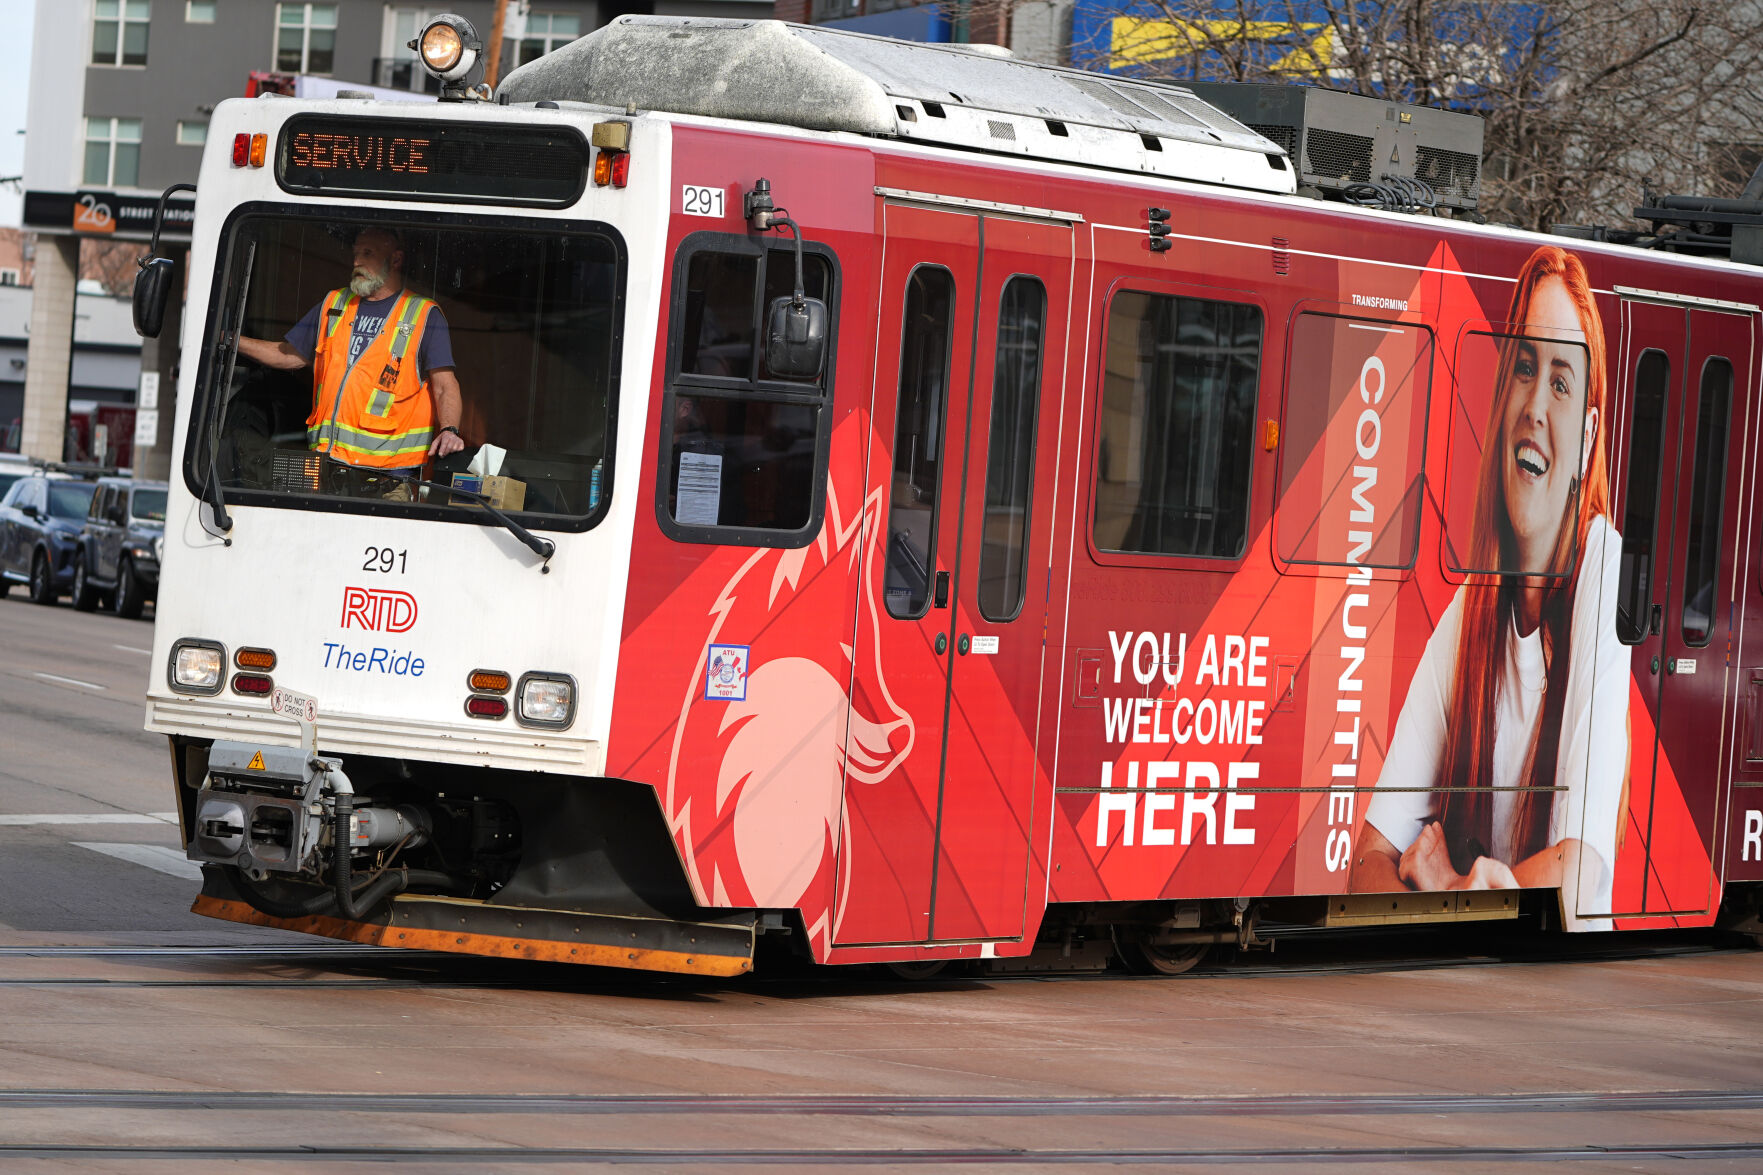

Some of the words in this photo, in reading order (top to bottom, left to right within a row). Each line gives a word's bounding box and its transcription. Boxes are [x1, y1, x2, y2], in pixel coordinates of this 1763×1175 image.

[291, 133, 431, 173] SERVICE
[78, 194, 112, 227] 20
[119, 206, 153, 219] STREET
[685, 187, 725, 216] 291
[1352, 293, 1408, 312] TRANSFORMING
[362, 546, 408, 574] 291
[341, 586, 418, 633] RTD
[1325, 355, 1386, 873] COMMUNITIES
[323, 642, 425, 677] TheRide
[1108, 630, 1187, 685] YOU
[1196, 635, 1270, 686] ARE
[284, 693, 293, 703] DO
[294, 697, 306, 707] NOT
[284, 704, 304, 717] CROSS
[1103, 698, 1266, 745] WELCOME
[1096, 761, 1261, 847] HERE
